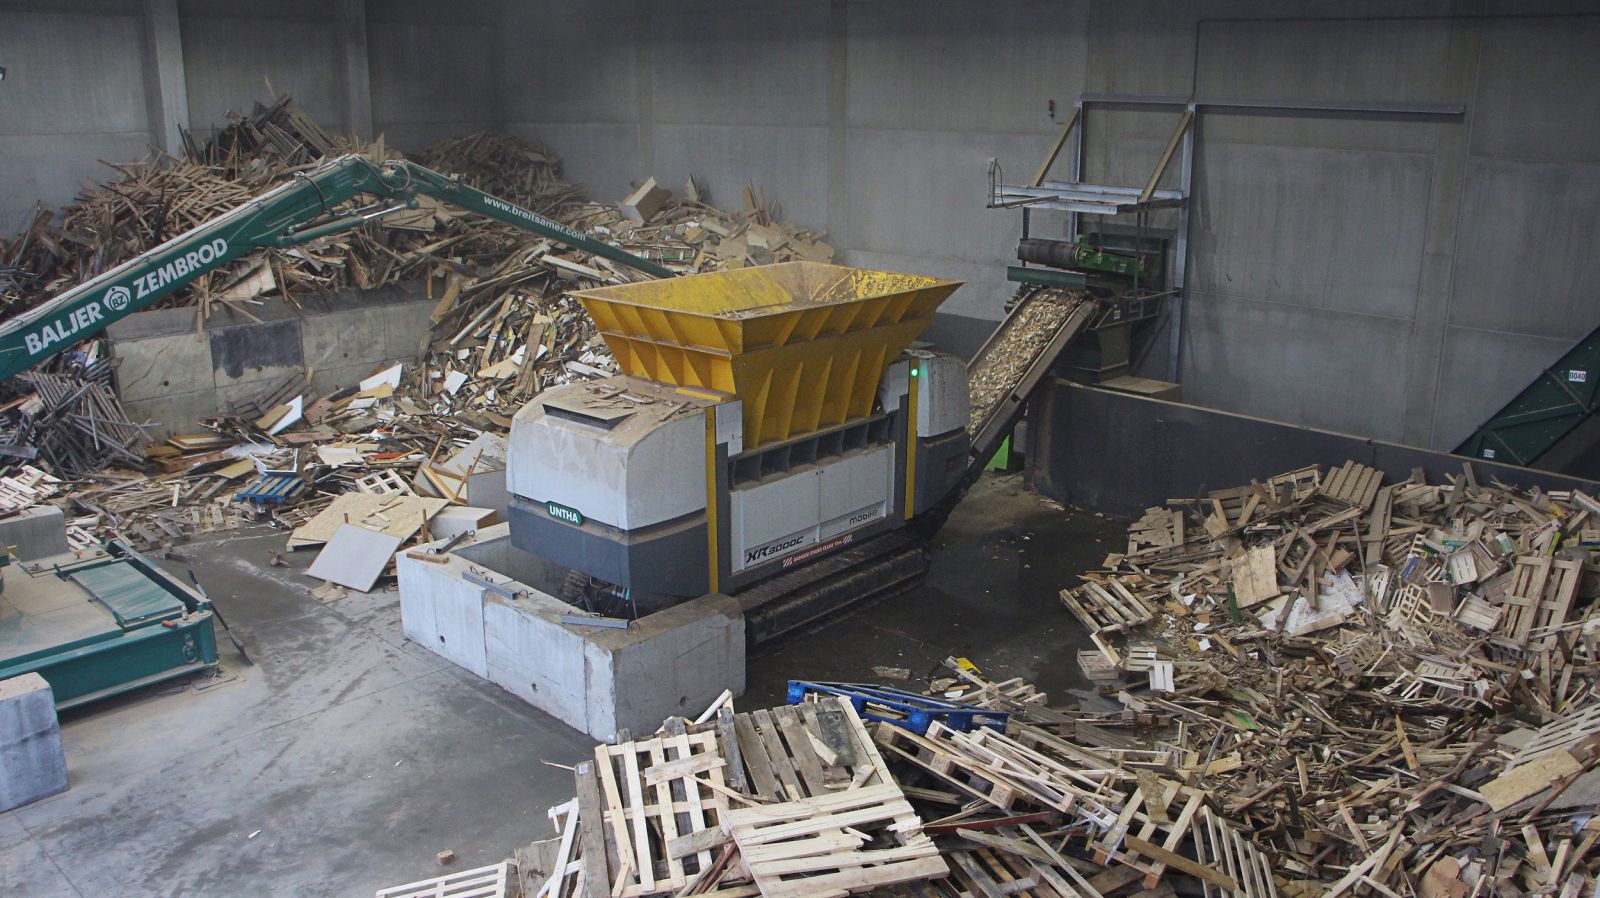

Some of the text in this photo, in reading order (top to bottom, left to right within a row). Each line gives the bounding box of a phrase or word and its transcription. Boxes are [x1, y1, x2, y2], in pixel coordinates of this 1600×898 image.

[483, 195, 587, 242] www.breitsamer.com
[24, 237, 229, 355] BALJER BZ ZEMBROD
[1569, 372, 1586, 380] 0040
[549, 505, 579, 524] UNTHA
